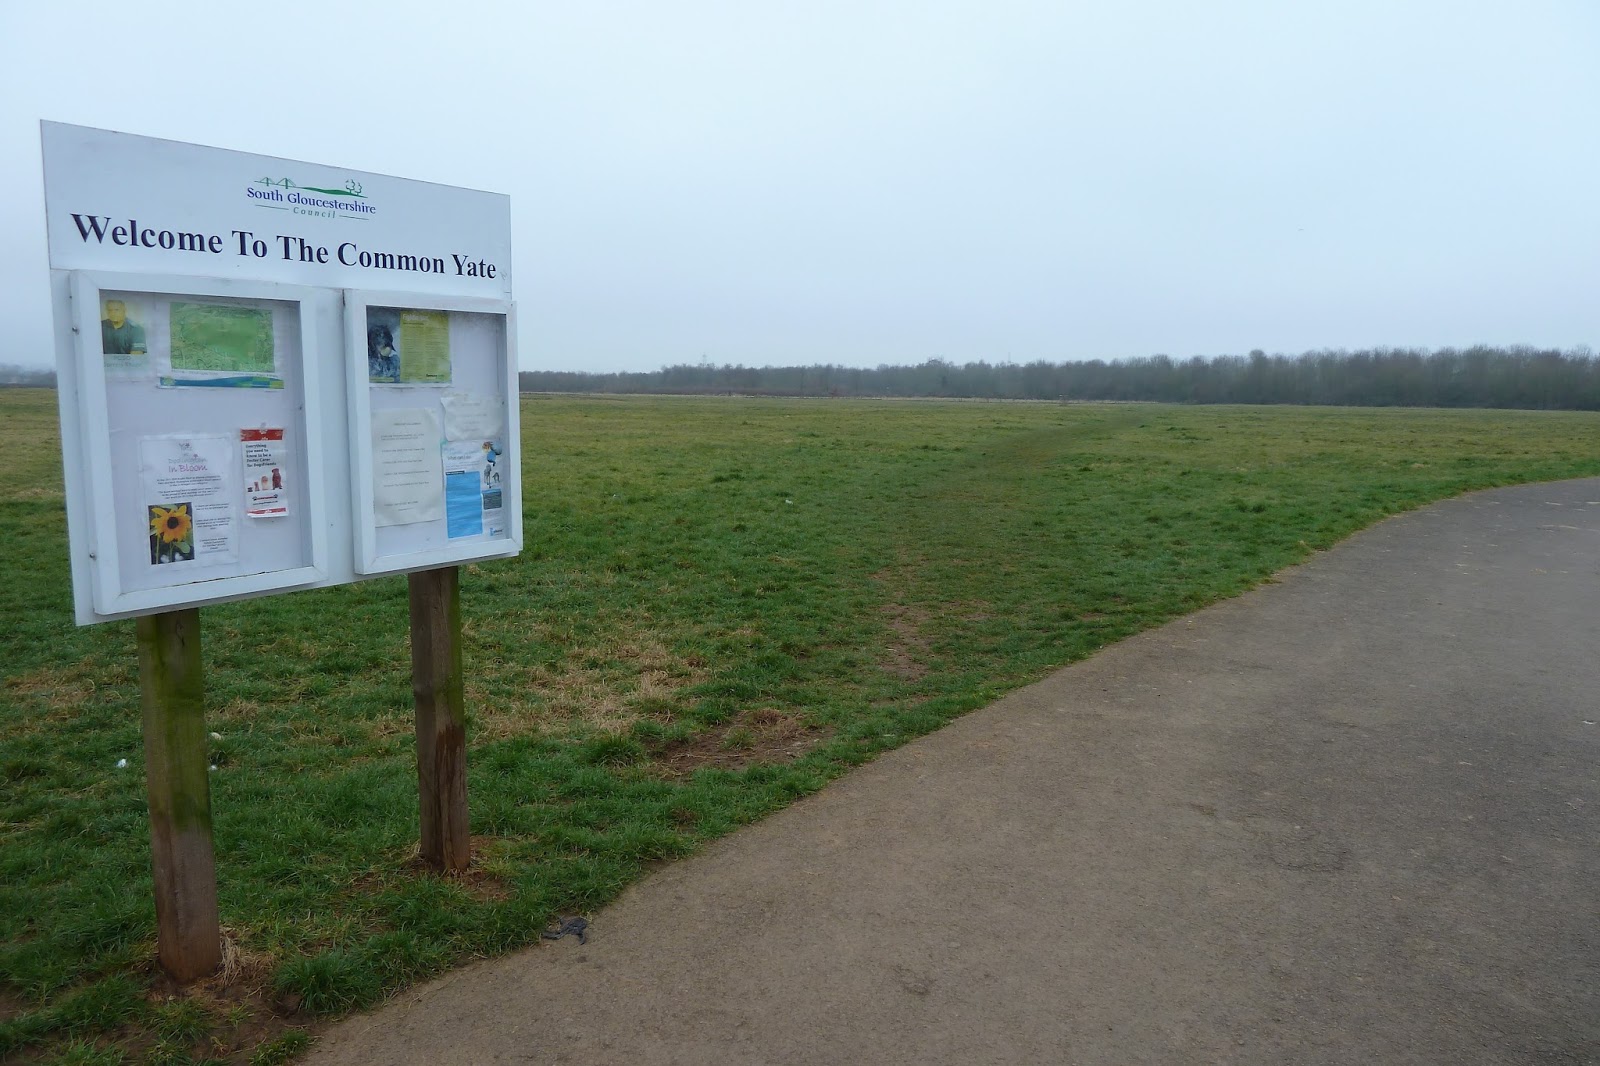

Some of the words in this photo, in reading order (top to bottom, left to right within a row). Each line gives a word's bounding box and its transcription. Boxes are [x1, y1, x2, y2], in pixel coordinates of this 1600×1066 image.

[247, 187, 284, 202] South
[287, 192, 376, 215] Gloucestershire
[293, 206, 336, 219] Council
[69, 213, 223, 254] Welcome
[231, 230, 268, 258] To
[276, 235, 329, 264] The
[337, 242, 445, 275] Common
[451, 253, 497, 279] Yate
[179, 464, 208, 473] Bloom
